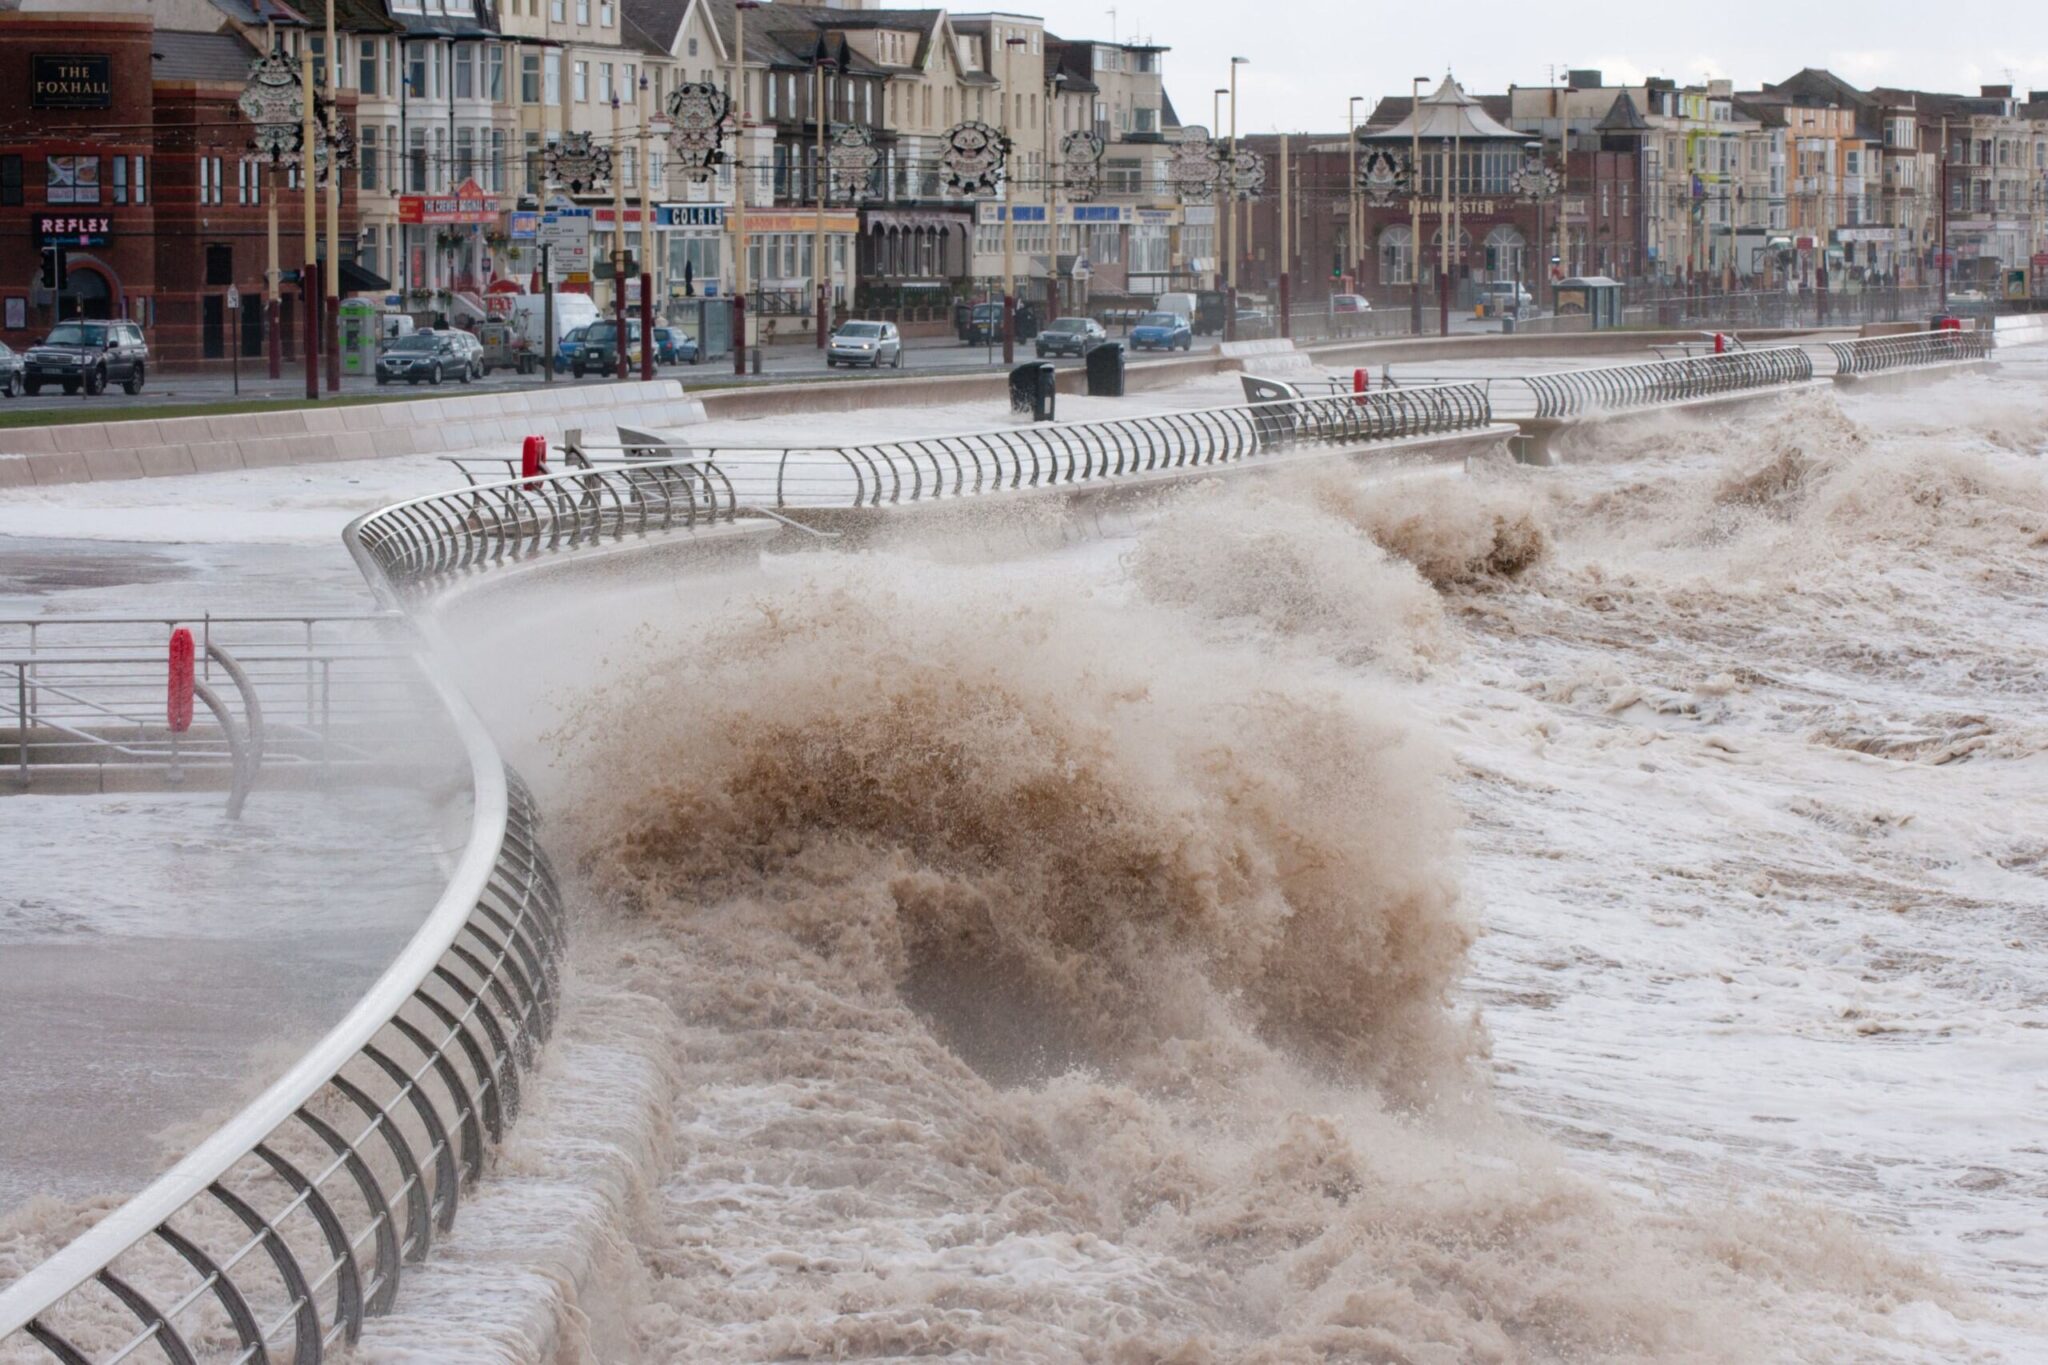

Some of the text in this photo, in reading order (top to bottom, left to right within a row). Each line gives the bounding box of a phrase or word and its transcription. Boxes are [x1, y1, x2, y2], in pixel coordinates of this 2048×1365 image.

[57, 66, 90, 78] THE
[36, 81, 109, 94] FOXHALL
[672, 208, 721, 226] COLRIS
[41, 218, 109, 233] REFLEX
